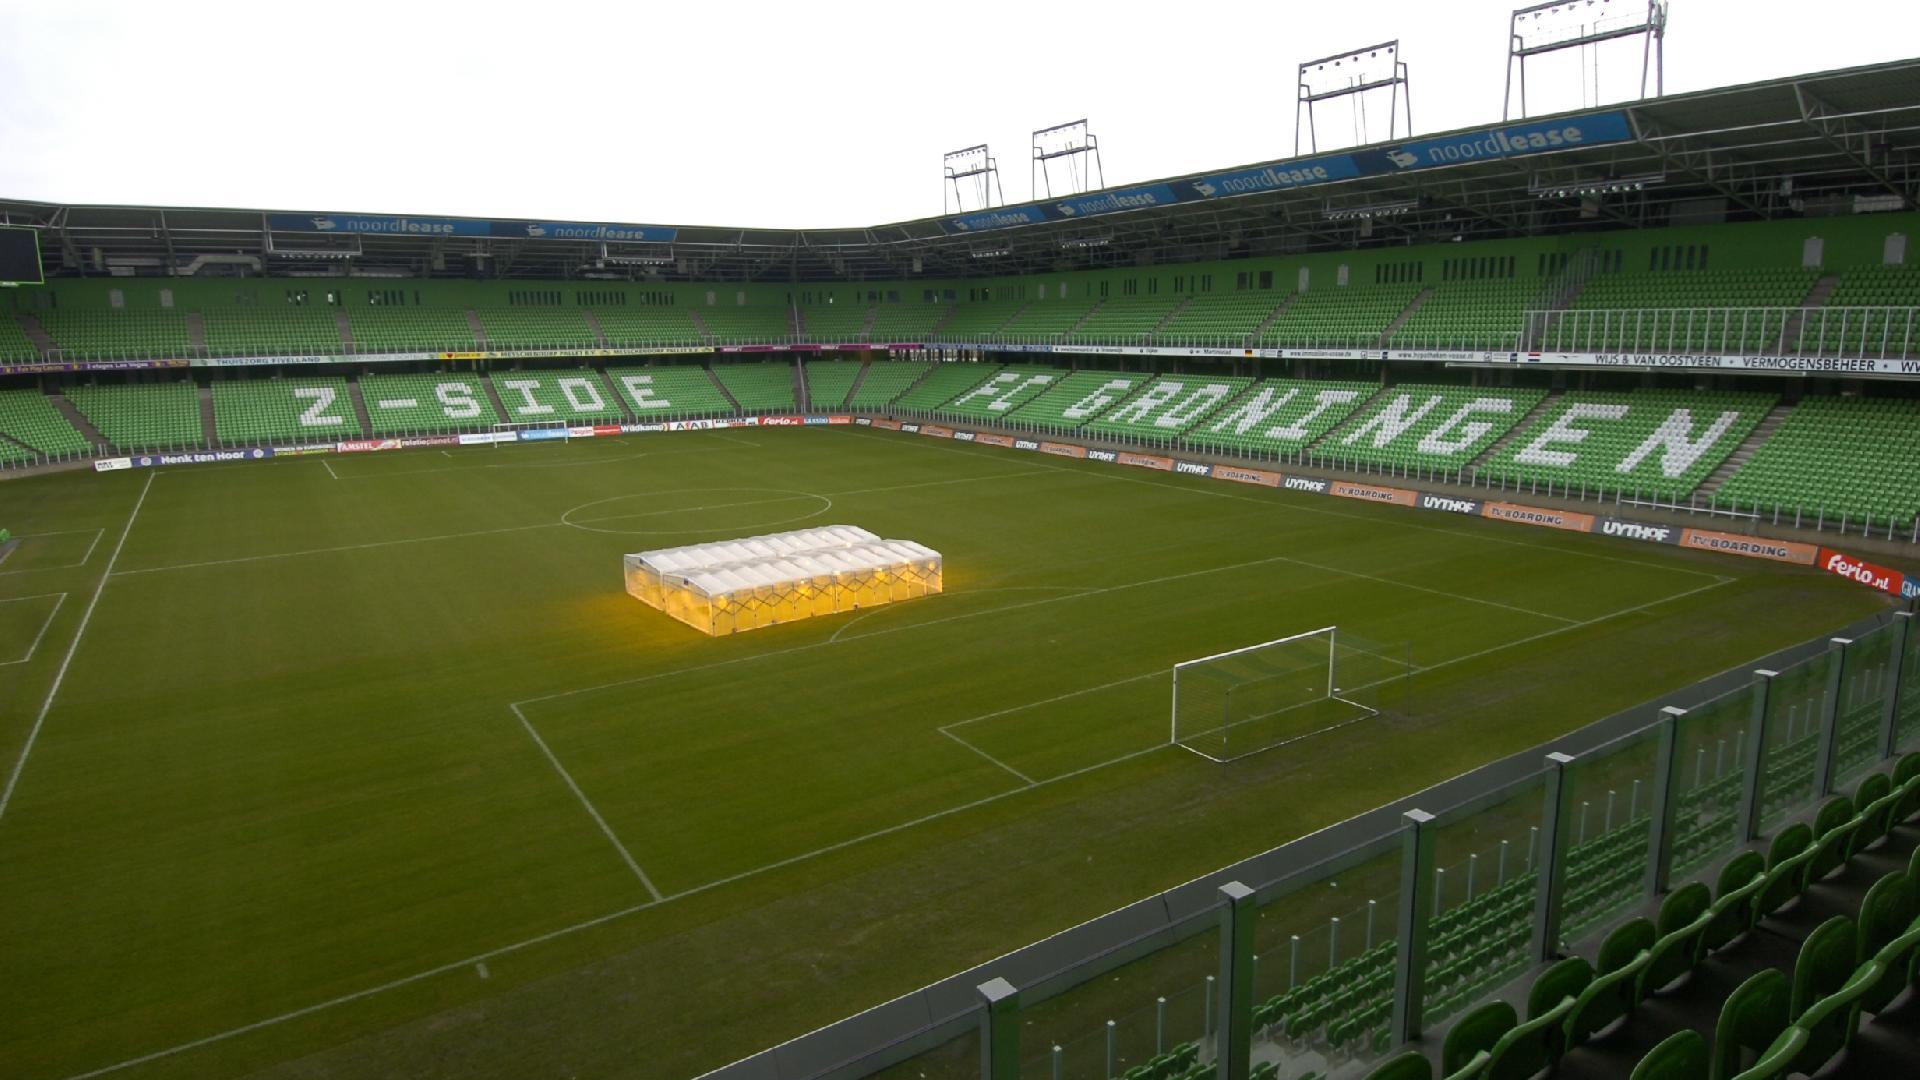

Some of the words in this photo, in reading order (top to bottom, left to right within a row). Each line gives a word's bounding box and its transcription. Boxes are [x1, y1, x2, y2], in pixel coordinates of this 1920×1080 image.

[1429, 125, 1583, 163] noordlease
[1221, 165, 1328, 193] noordlease
[1079, 190, 1156, 214] noordlease
[347, 217, 455, 233] noordlease
[555, 226, 645, 239] noordlease
[1595, 354, 1619, 364] WIJS
[1633, 354, 1656, 365] VAN
[1658, 355, 1722, 367] OOSTVEEN
[1742, 357, 1876, 371] VERMOGENSBEHEER
[160, 454, 192, 465] Henk
[194, 453, 215, 463] ten
[1177, 462, 1209, 476] UYTHOF
[1284, 477, 1326, 493] UYTHOF
[1423, 496, 1476, 513] UYTHOF
[1503, 508, 1563, 526] BOARDING
[1602, 520, 1671, 542] UYTHOF
[1709, 538, 1787, 558] BOARDING
